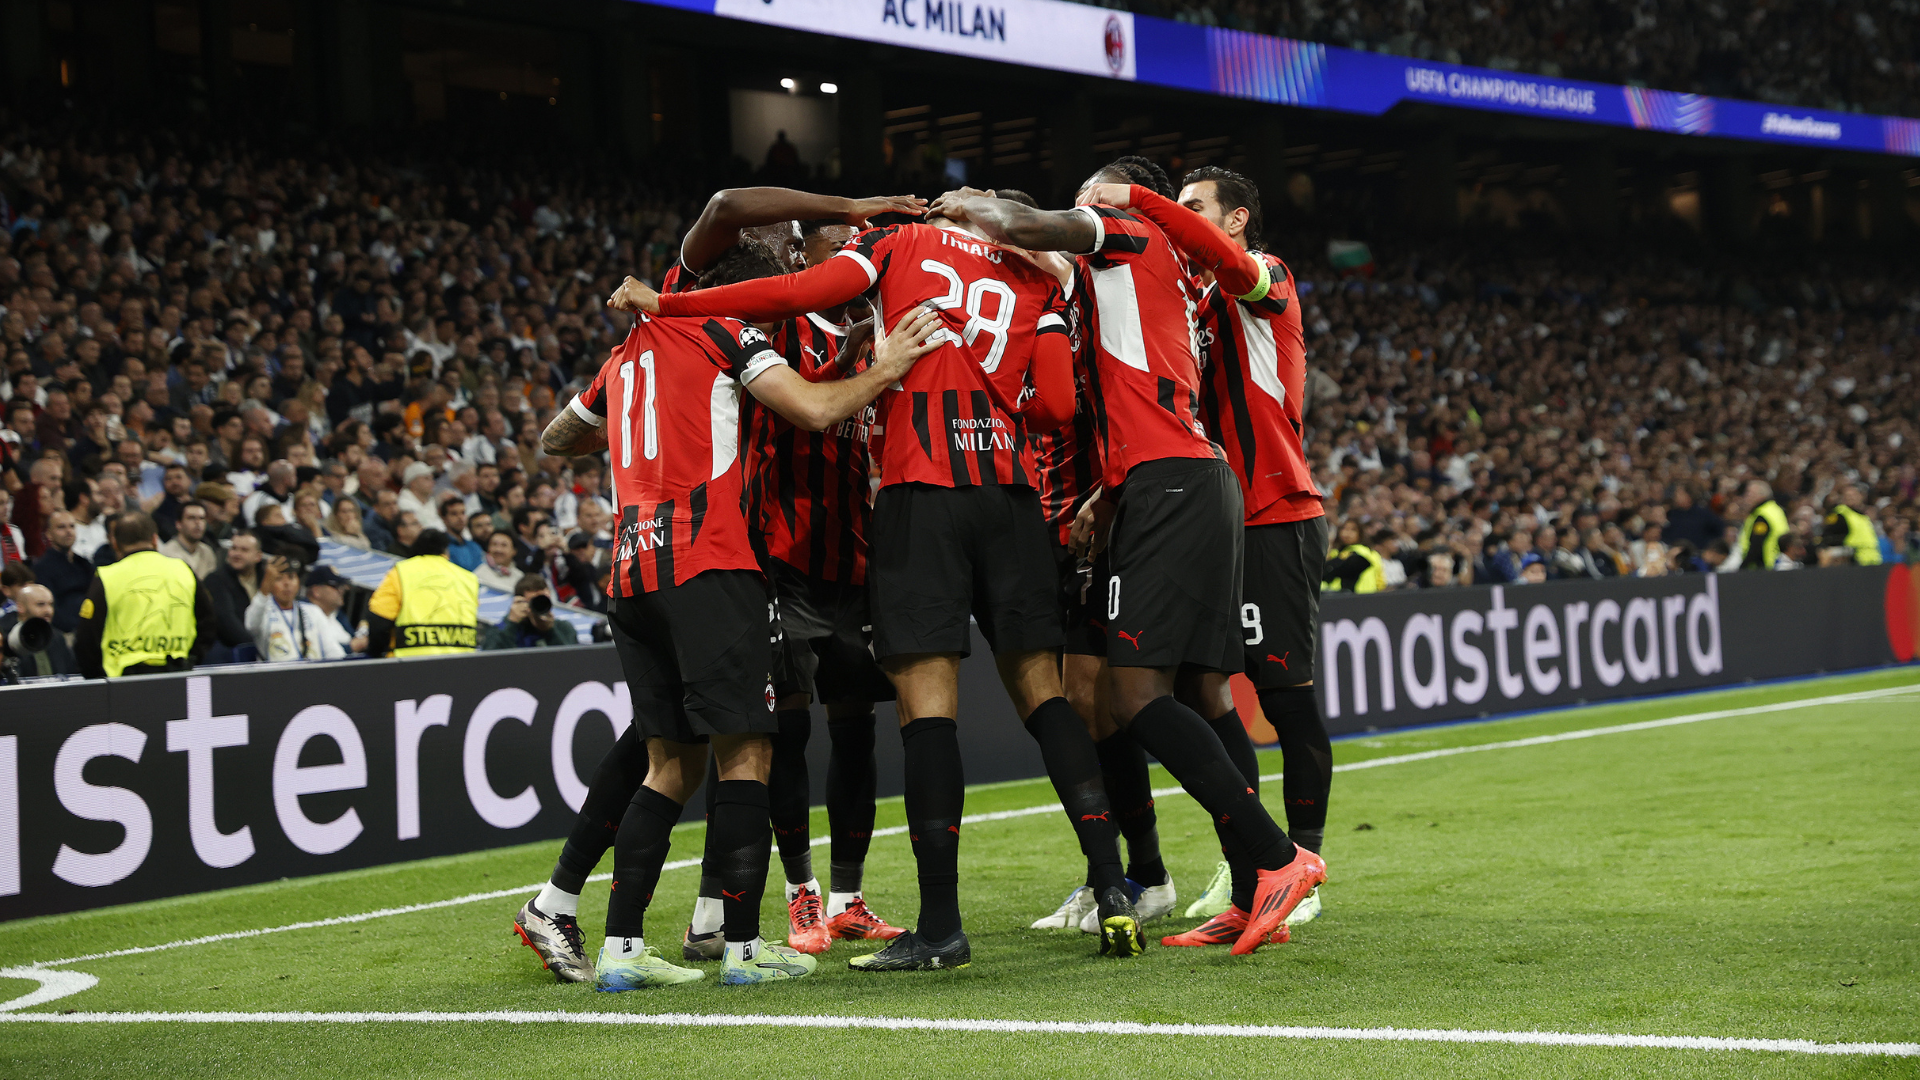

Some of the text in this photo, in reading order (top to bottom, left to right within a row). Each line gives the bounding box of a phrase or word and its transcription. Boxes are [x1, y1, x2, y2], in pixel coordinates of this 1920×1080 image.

[884, 0, 1005, 41] AC MILAN
[1405, 66, 1597, 115] UEFA CHAMPIONS LEAGUE
[941, 230, 1003, 265] THIAW
[917, 259, 1016, 374] 28
[620, 349, 658, 469] 11
[836, 421, 869, 444] BETTER
[954, 431, 1016, 452] MILAN
[626, 516, 664, 534] AZIONE
[1108, 575, 1121, 621] 0
[1241, 602, 1264, 646] 9
[1321, 572, 1724, 719] mastercard
[0, 675, 634, 897] sterca
